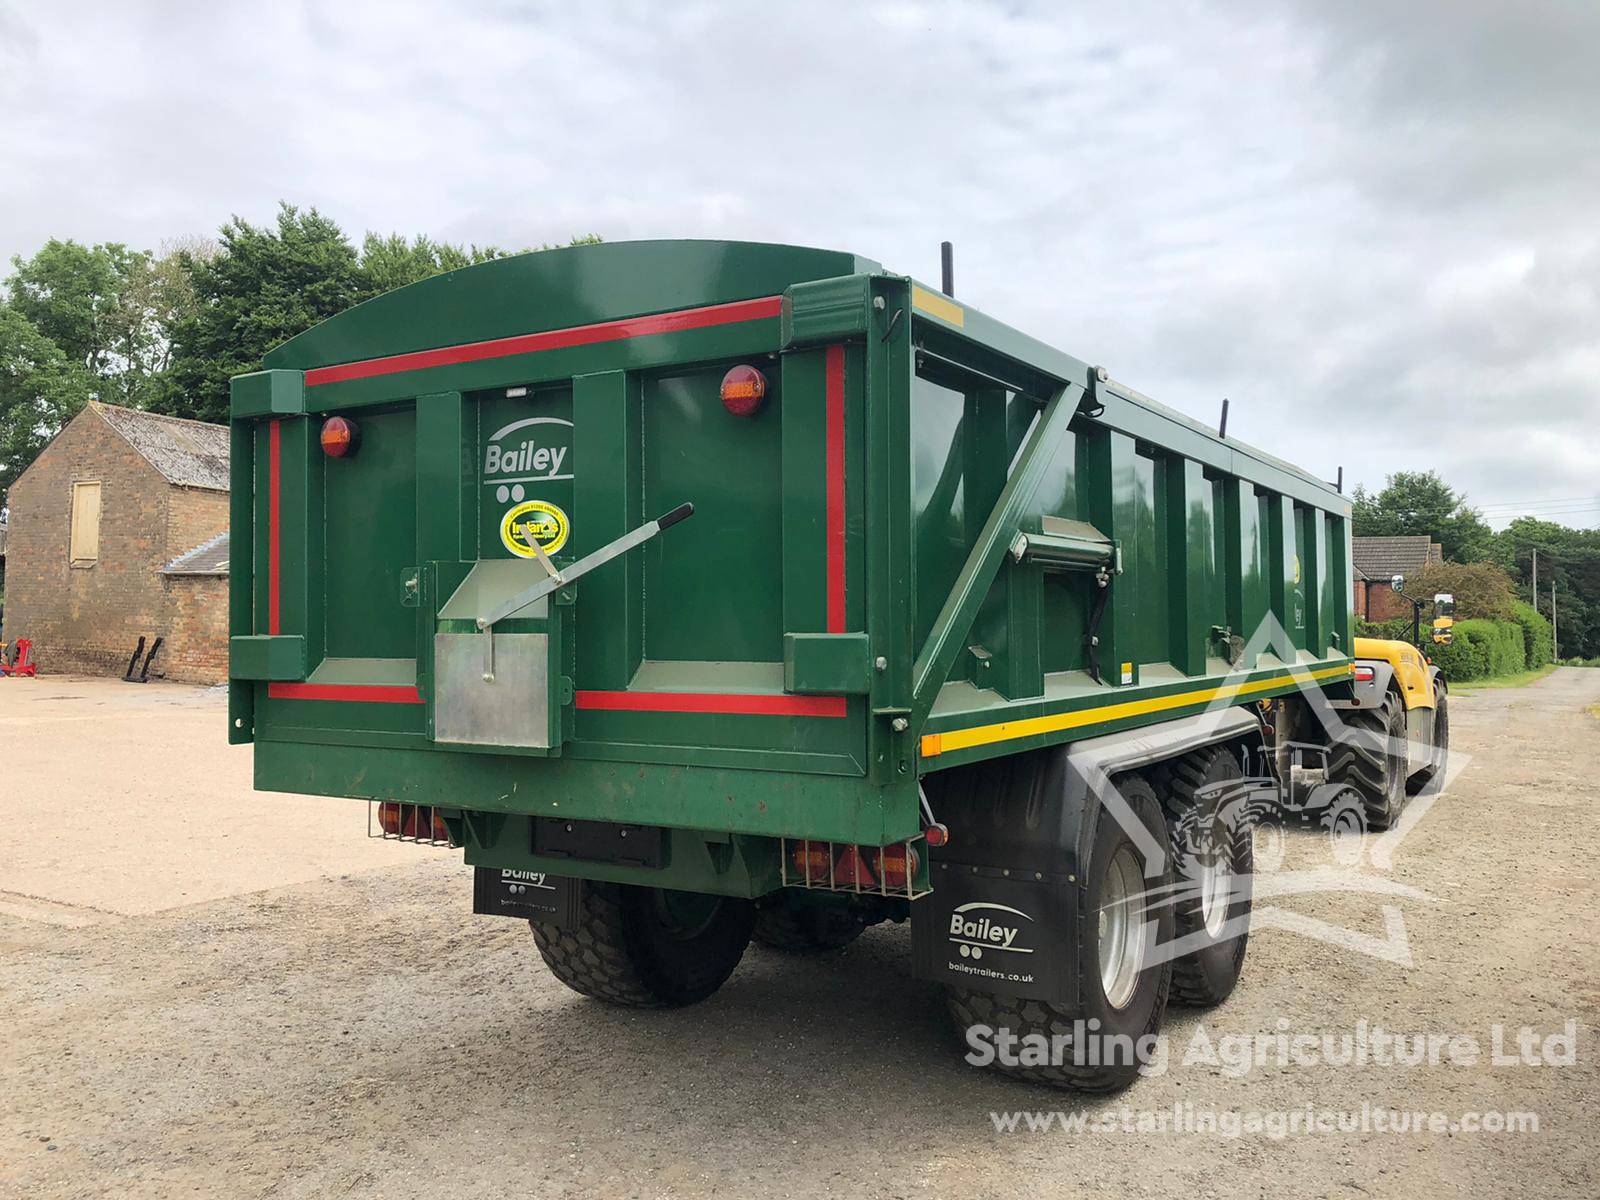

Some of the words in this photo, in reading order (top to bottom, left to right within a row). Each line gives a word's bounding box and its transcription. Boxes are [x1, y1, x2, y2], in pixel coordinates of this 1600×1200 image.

[484, 440, 567, 477] Bailey
[950, 914, 1018, 947] Bailey
[948, 961, 1034, 982] baileytrailers.co.uk
